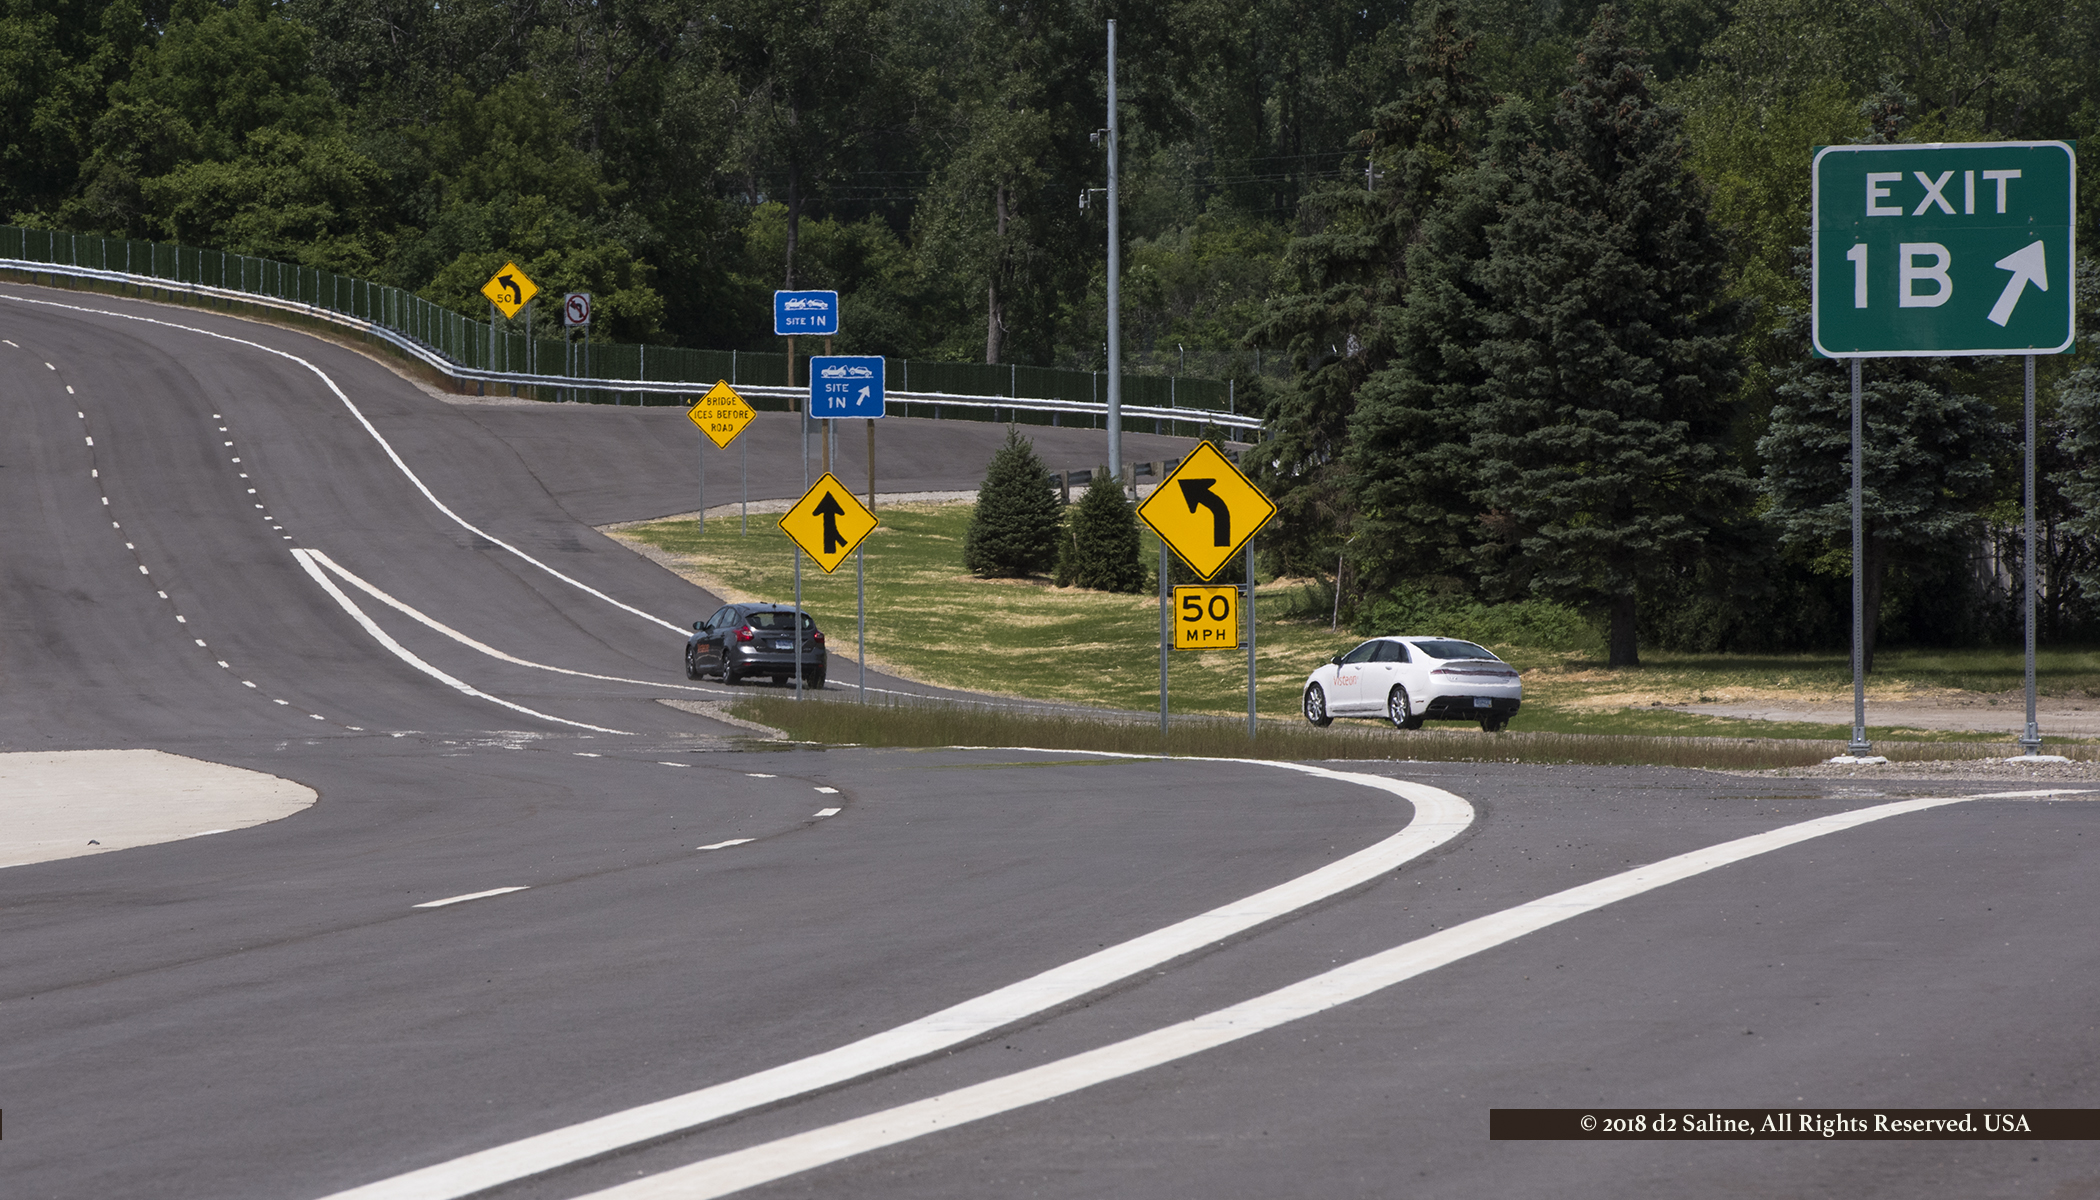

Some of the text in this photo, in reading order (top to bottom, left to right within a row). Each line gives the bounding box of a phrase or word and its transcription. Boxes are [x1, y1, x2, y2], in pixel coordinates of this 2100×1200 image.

[1866, 169, 2022, 217] EXIT
[497, 294, 512, 303] 50
[785, 315, 826, 327] SITE 1N
[825, 383, 849, 393] SITE
[706, 397, 737, 406] BRIDGE
[828, 396, 846, 409] 1N
[694, 410, 749, 419] ICES BEFORE
[710, 423, 734, 432] ROAD
[1182, 594, 1230, 622] 50
[1186, 628, 1226, 642] MPH
